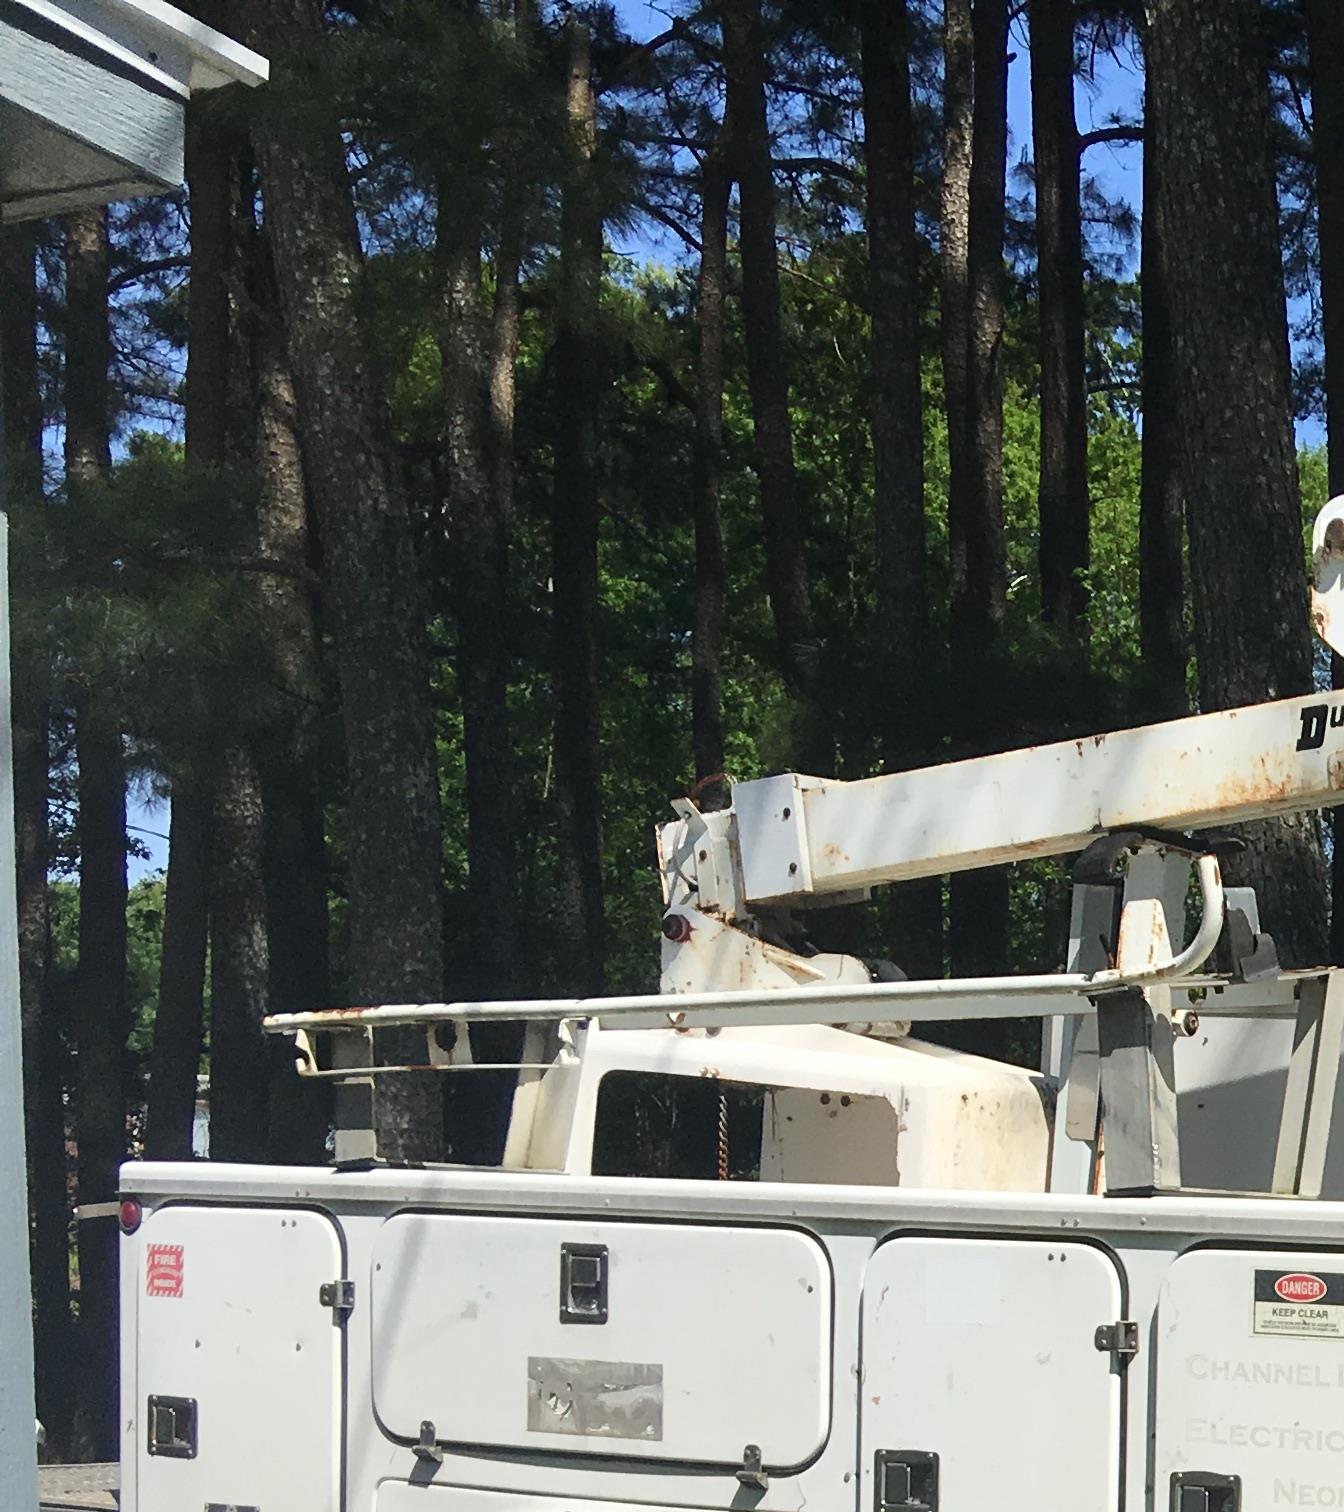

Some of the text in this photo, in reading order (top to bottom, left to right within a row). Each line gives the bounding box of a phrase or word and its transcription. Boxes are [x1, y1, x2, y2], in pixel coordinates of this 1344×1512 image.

[154, 1254, 177, 1266] FIRE
[1281, 1280, 1320, 1296] DANGER
[1272, 1307, 1329, 1319] KEEP CLEAR
[1185, 1353, 1330, 1389] CHANNEL
